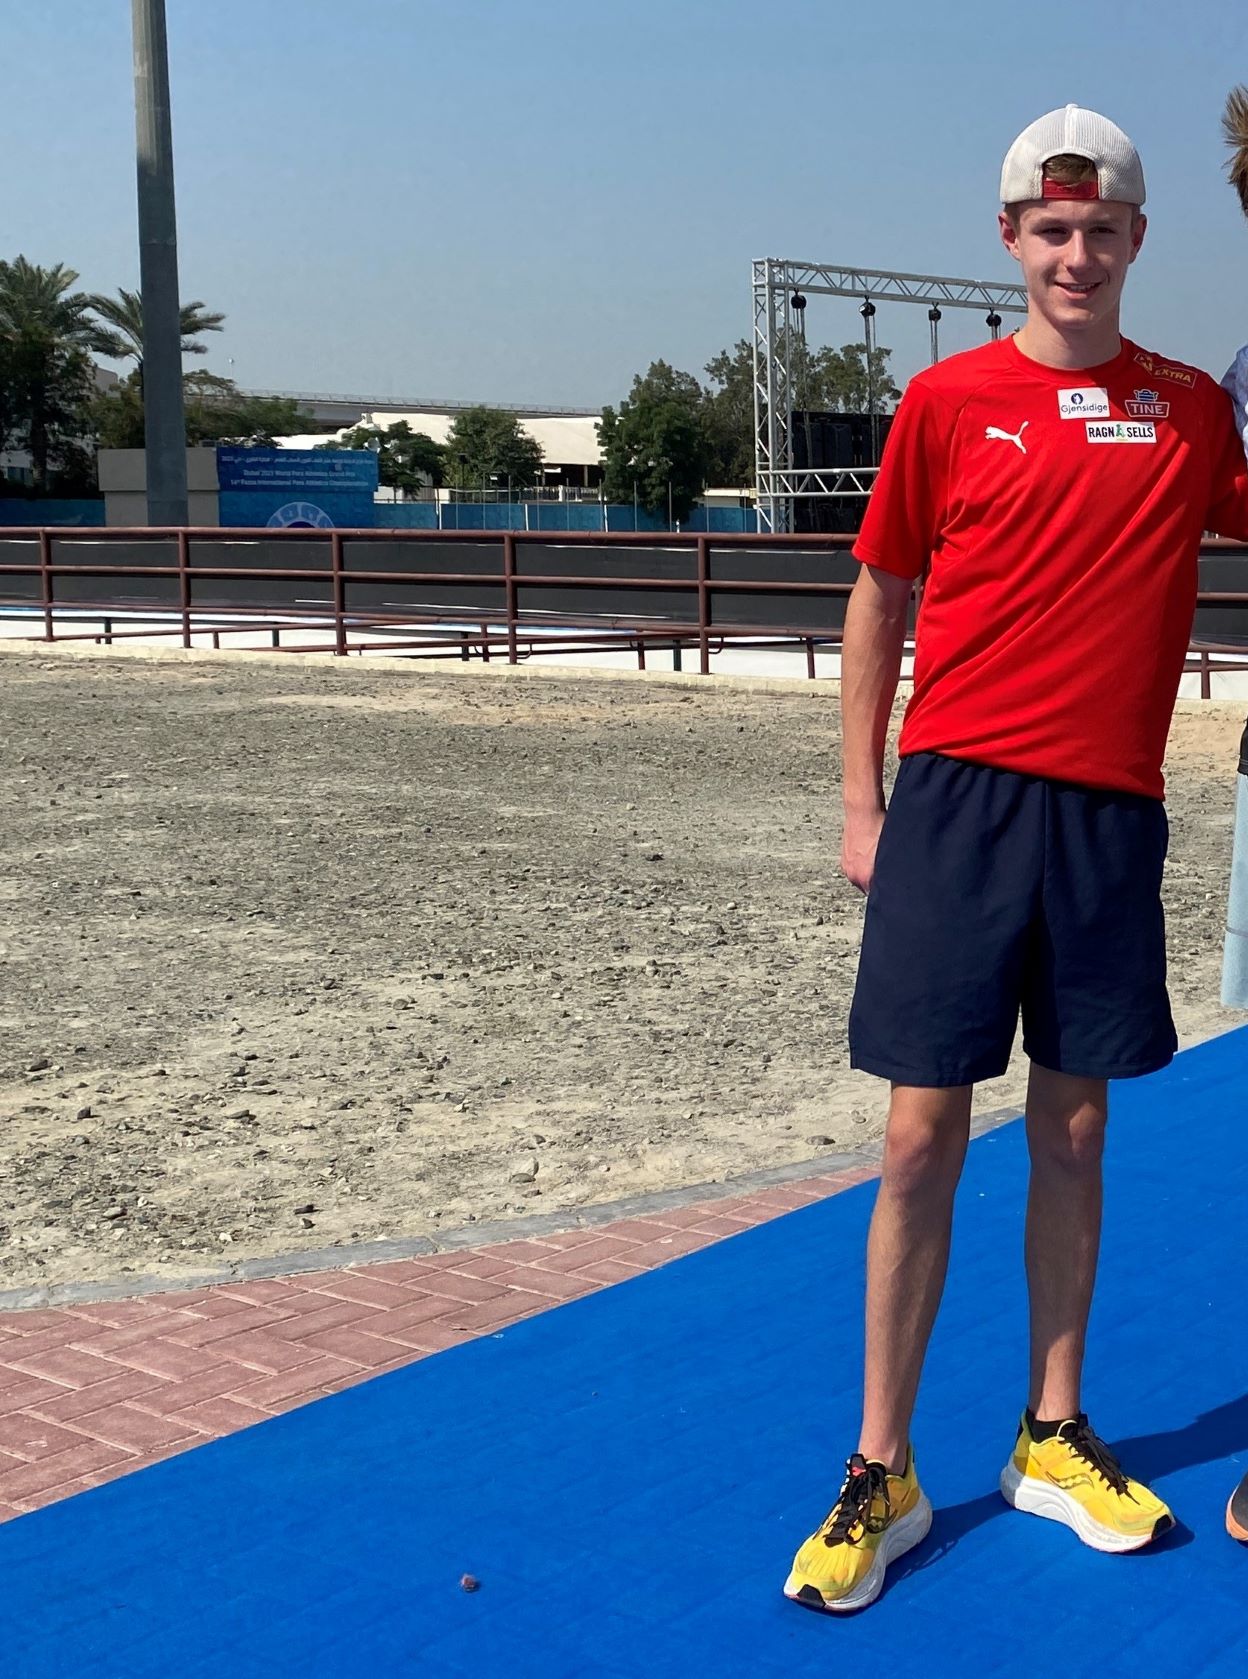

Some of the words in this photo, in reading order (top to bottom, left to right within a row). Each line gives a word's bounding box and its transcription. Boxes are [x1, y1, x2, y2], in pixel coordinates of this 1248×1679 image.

[1060, 402, 1108, 415] Gjensidige
[1130, 403, 1165, 416] TINE
[1088, 426, 1115, 438] RAGN
[1127, 426, 1154, 438] SELLS
